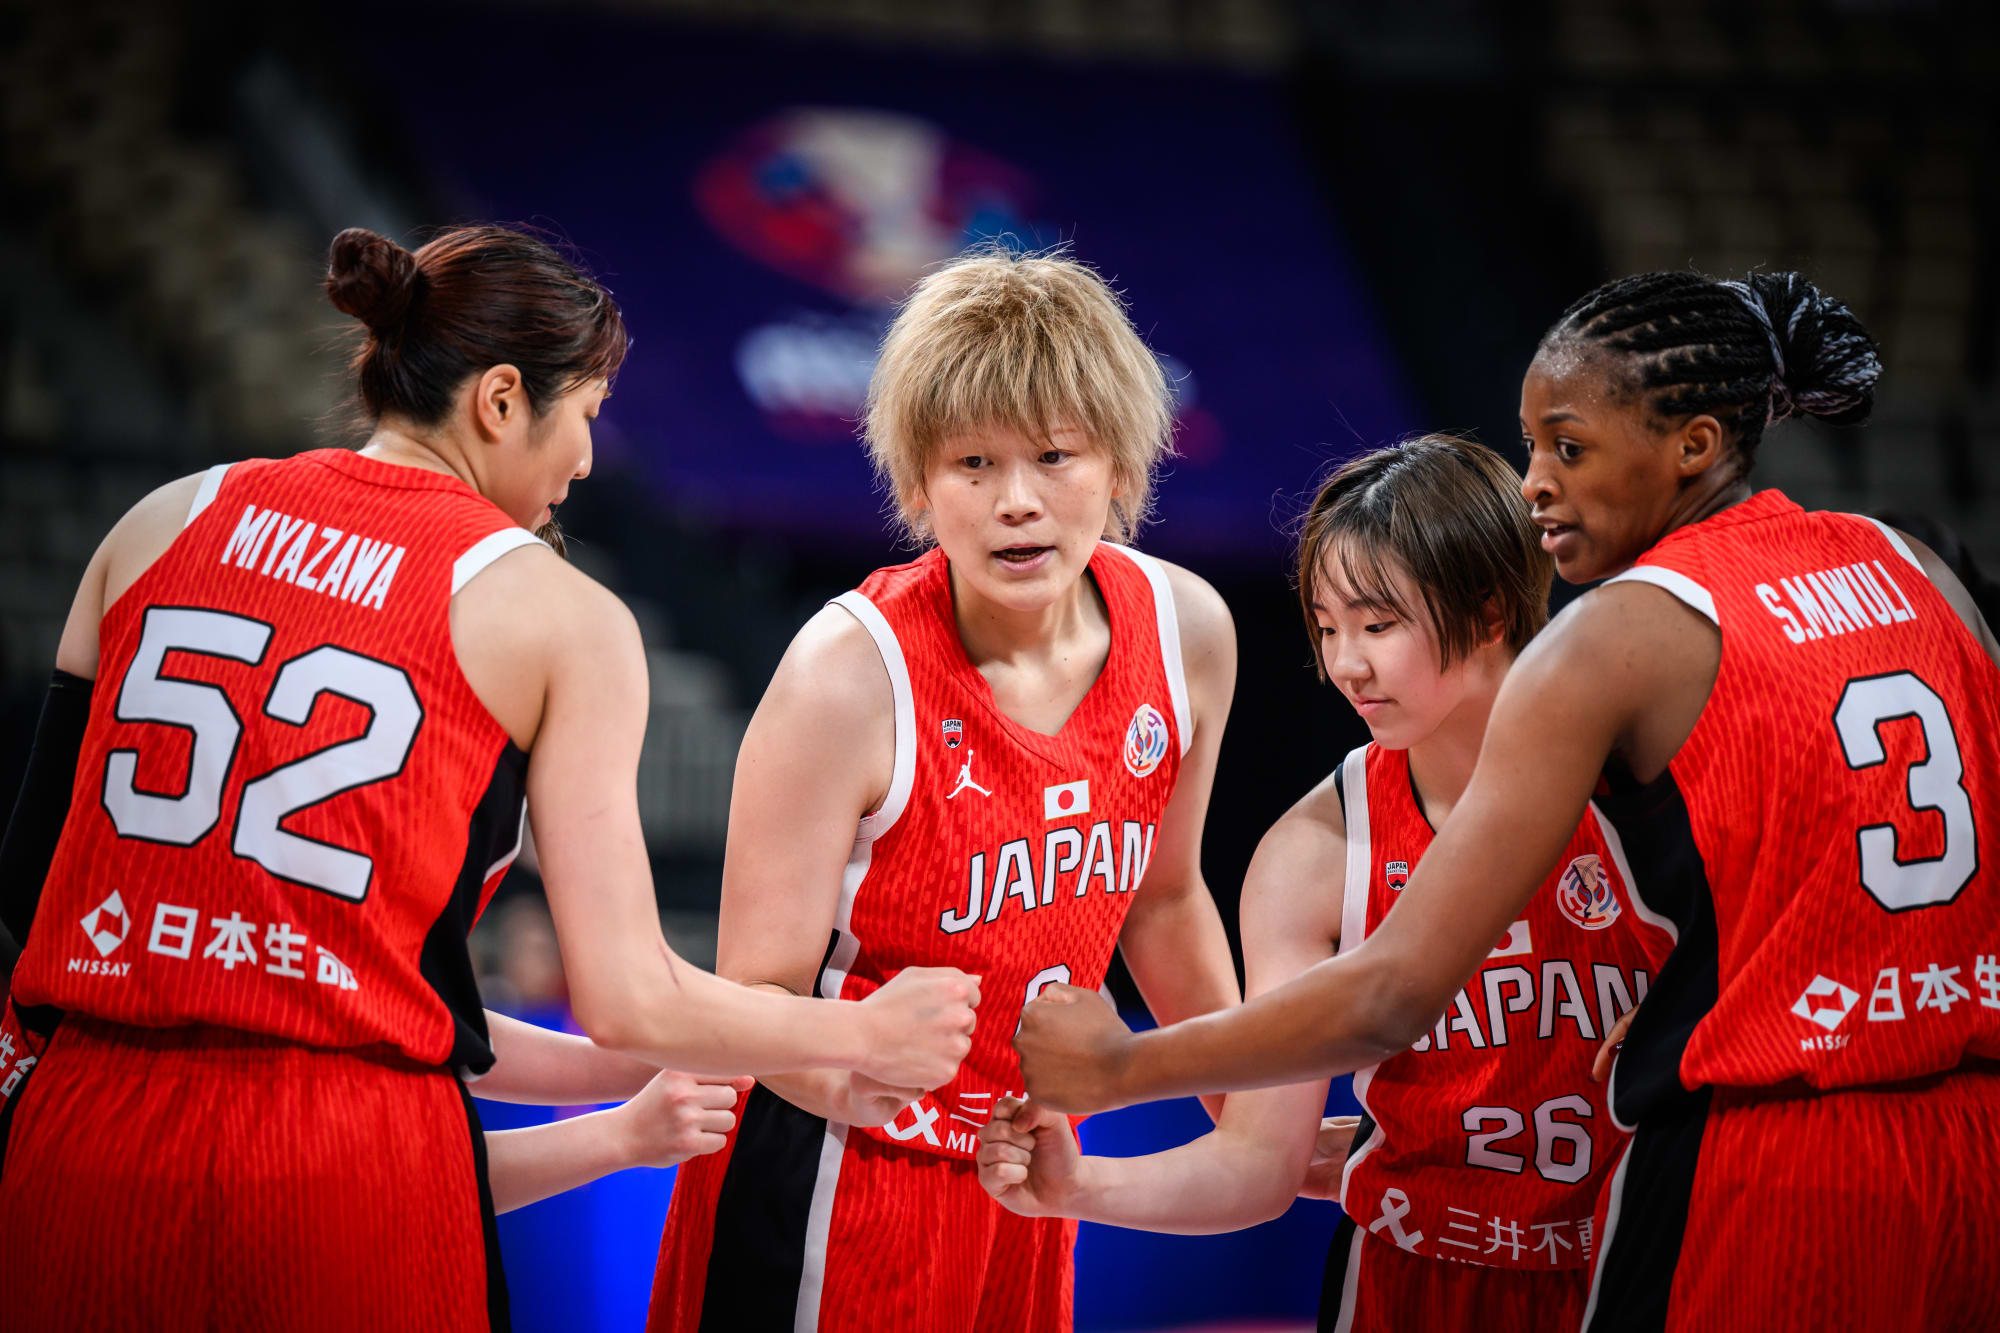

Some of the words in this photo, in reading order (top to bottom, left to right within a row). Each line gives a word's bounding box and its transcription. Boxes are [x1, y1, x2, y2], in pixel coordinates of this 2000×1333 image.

[220, 504, 406, 611] MIYAZAWA
[1755, 559, 1918, 645] S.MAWULI
[101, 604, 425, 904] 52
[1833, 670, 1979, 914] 3
[939, 820, 1155, 935] JAPAN
[1387, 862, 1407, 870] JAPAN
[67, 957, 131, 977] NISSAY
[1462, 1093, 1594, 1185] 26
